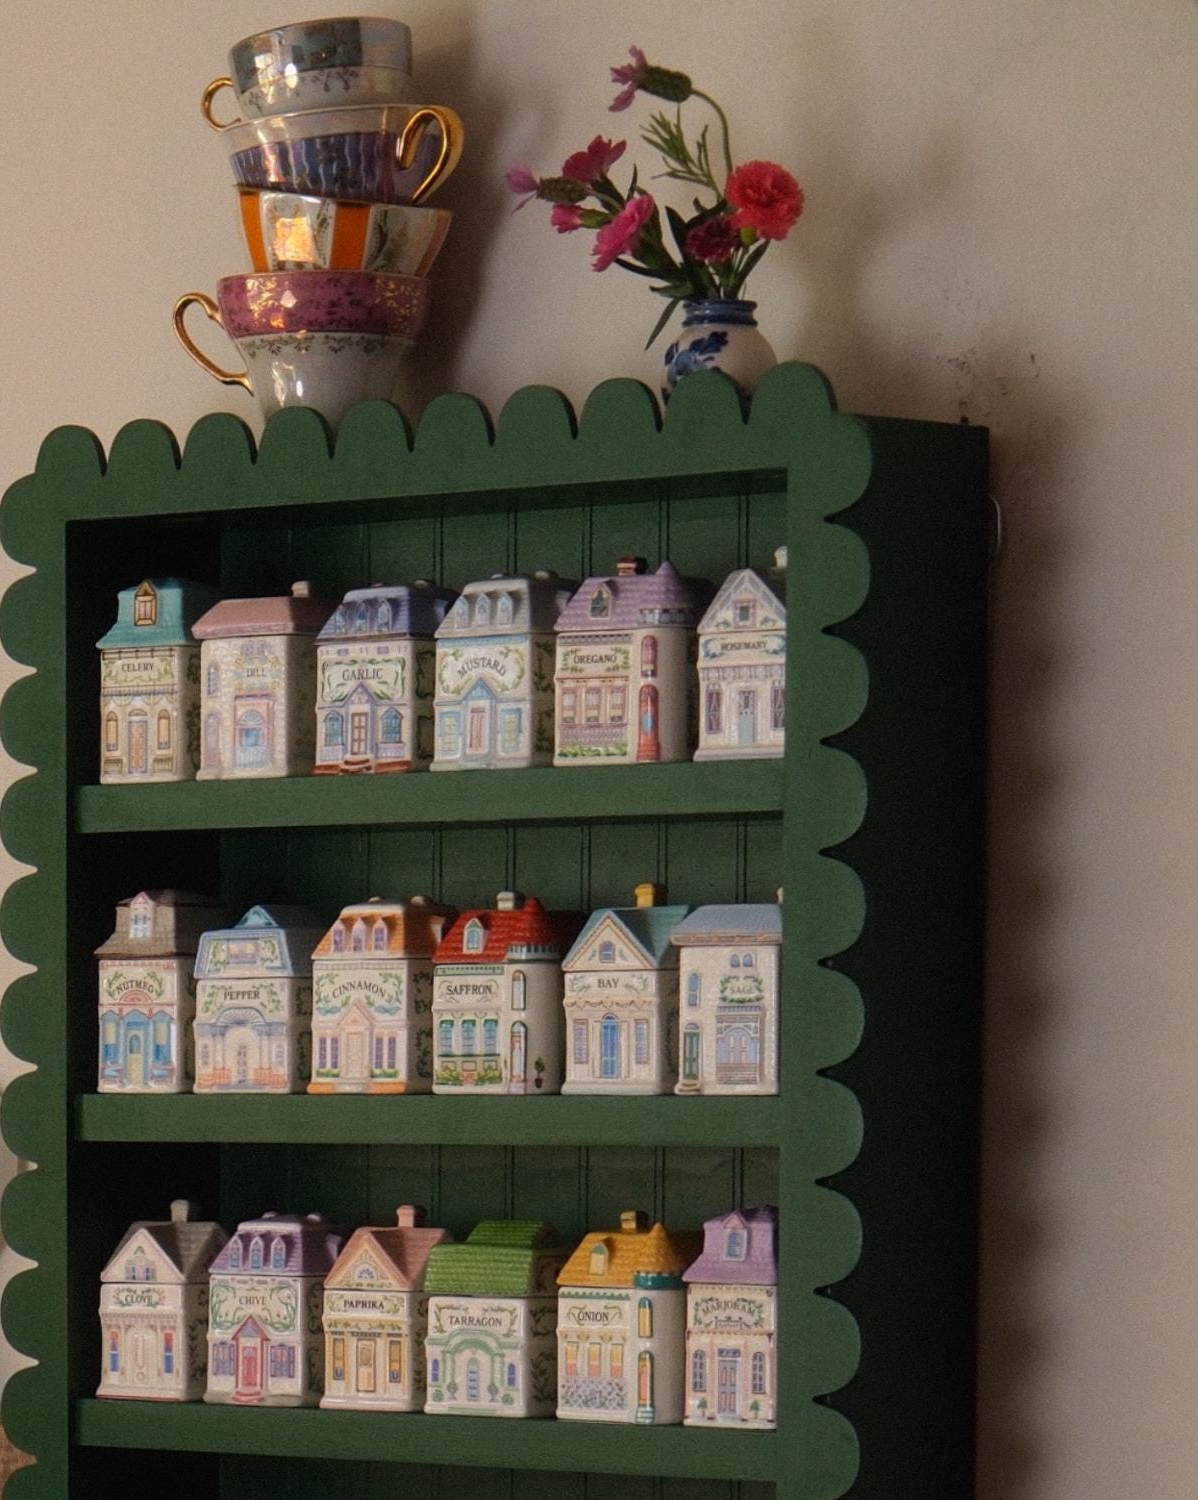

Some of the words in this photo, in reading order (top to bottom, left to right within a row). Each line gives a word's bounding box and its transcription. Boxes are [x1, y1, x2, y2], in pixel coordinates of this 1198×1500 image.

[720, 640, 769, 651] ROSEMARY
[573, 654, 618, 665] OREGANO
[121, 662, 156, 673] CELERY
[246, 667, 267, 678] DILL
[457, 656, 508, 679] MUSTARD
[341, 667, 383, 682] GARLIC
[115, 979, 155, 994] NUTMEG
[331, 980, 387, 998] CINNAMON
[597, 978, 620, 989] BAY
[445, 983, 493, 996] SAFFRON
[223, 990, 261, 1001] PEPPER
[124, 1294, 152, 1305] CLOVE
[238, 1295, 267, 1305] CHIVE
[343, 1299, 385, 1310] PAPRIKA
[701, 1300, 755, 1316] MARJORAM
[448, 1315, 503, 1327] TARRAGON
[577, 1310, 610, 1322] ONION
